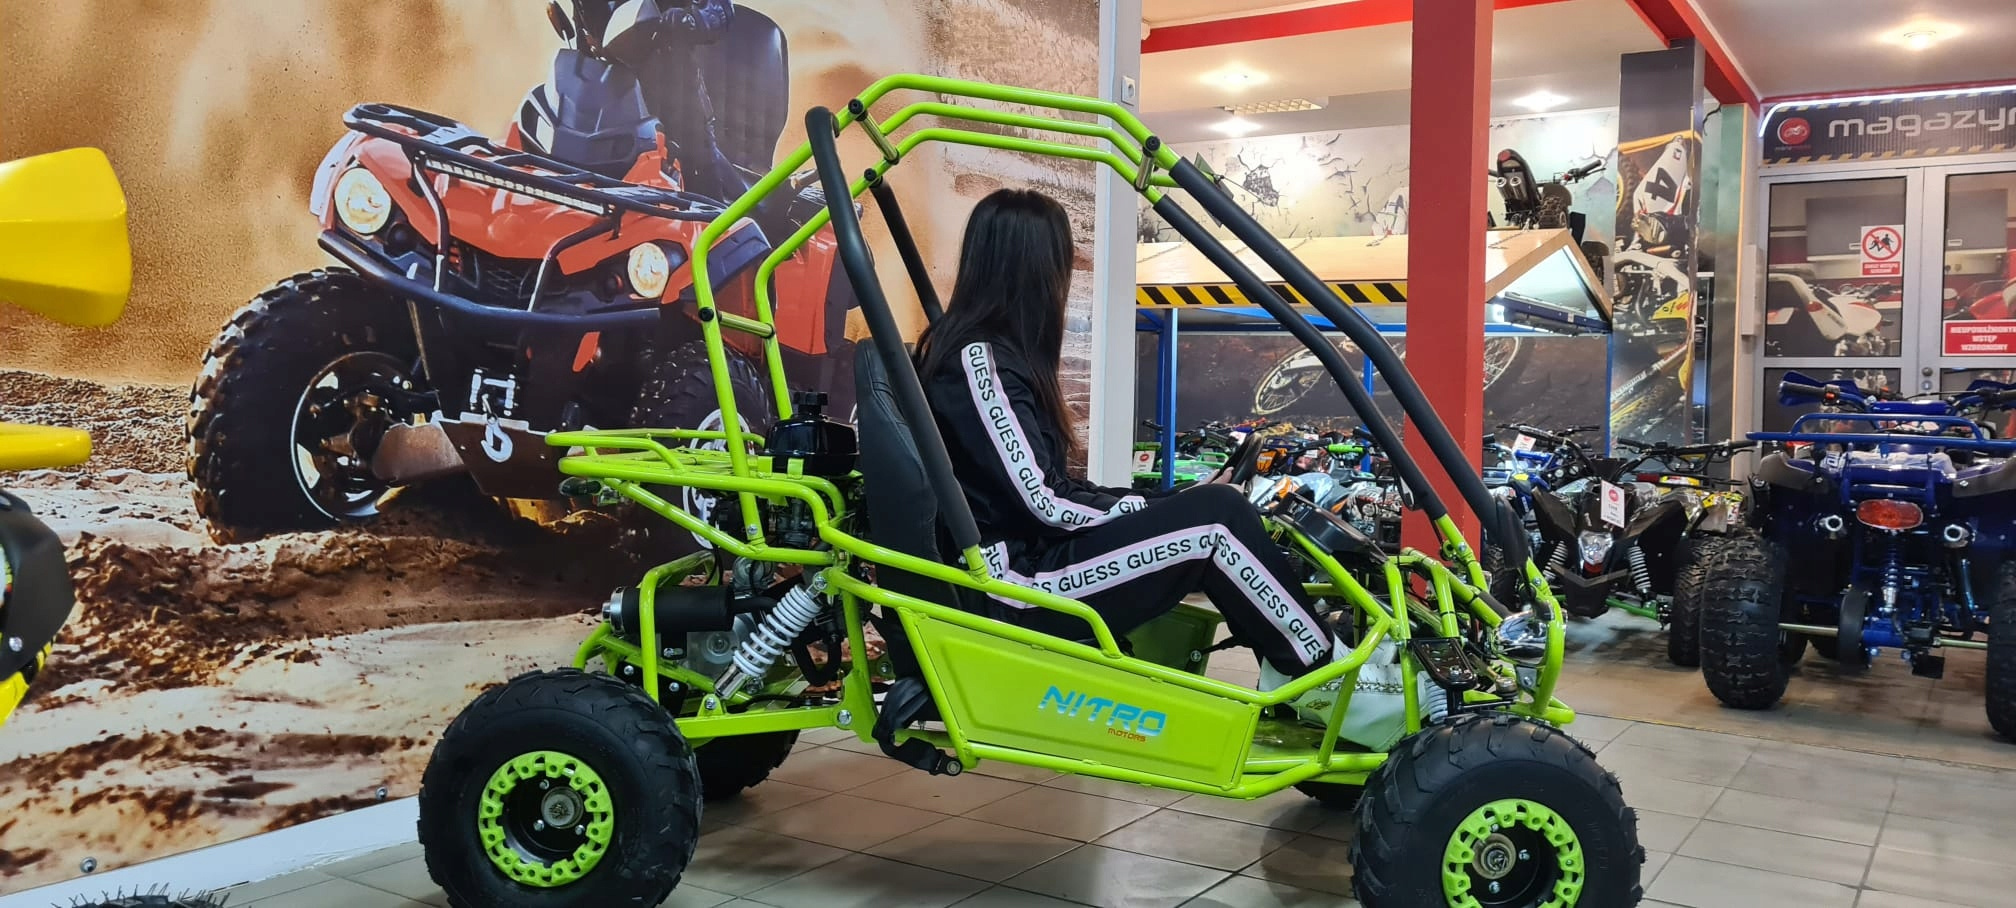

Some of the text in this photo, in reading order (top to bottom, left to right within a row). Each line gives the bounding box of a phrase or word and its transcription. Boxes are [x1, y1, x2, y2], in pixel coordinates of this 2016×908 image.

[1644, 167, 1678, 203] 4
[968, 345, 996, 402] GUESS
[989, 406, 1025, 463] GUESS
[1019, 467, 1056, 518] GUESS
[1058, 561, 1121, 592] GUESS
[1127, 539, 1192, 569] GUESS
[1240, 566, 1289, 619] GUESS
[1038, 685, 1168, 737] NITRO
[1107, 727, 1147, 743] MOTORS
